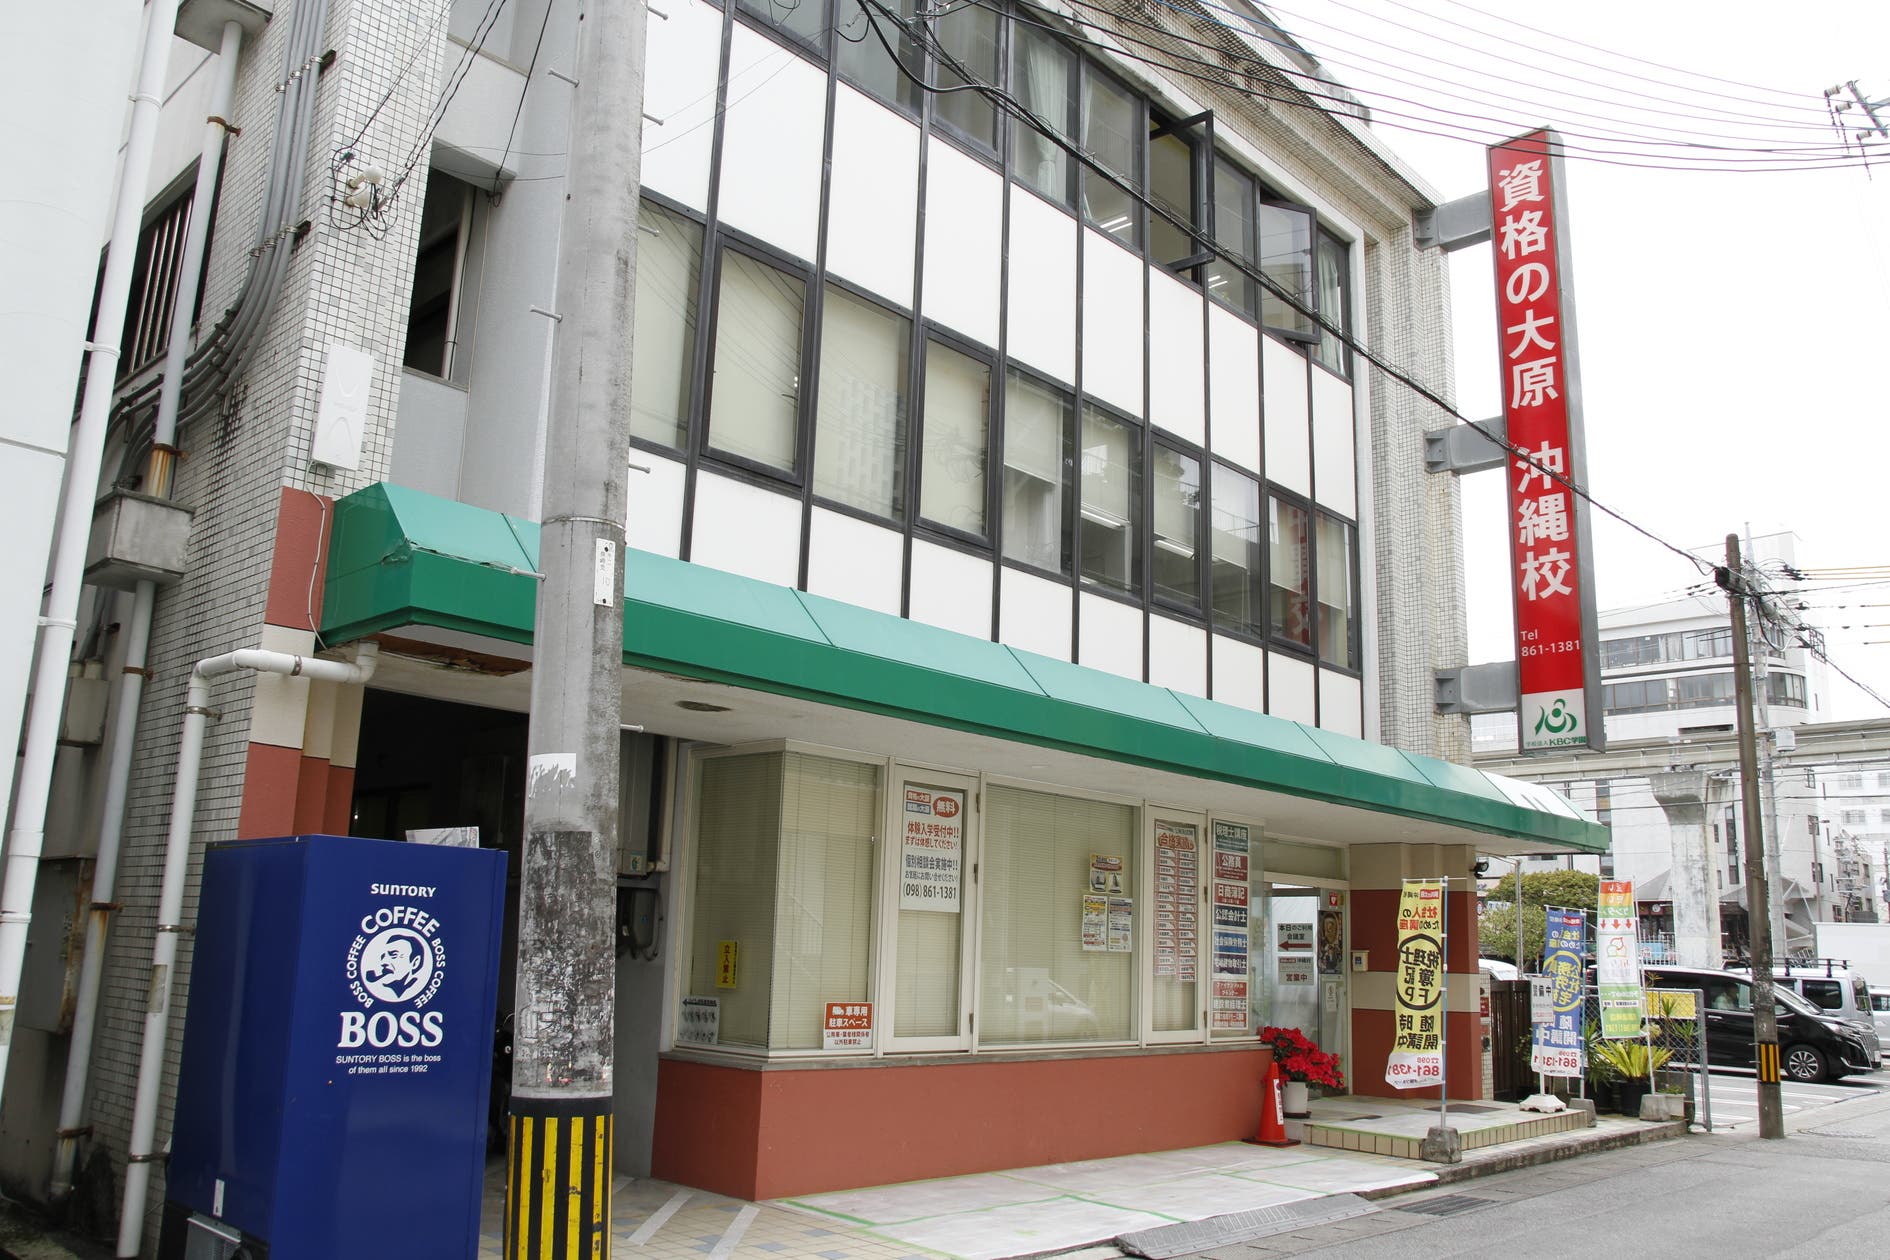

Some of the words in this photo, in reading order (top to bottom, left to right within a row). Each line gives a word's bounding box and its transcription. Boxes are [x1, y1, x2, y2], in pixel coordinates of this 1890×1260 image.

[1497, 159, 1559, 409] 資格の大原
[1514, 440, 1573, 601] 沖縄校
[1520, 629, 1538, 641] Tel
[1521, 639, 1581, 658] 861-1381
[370, 883, 437, 898] SUNTORY
[361, 906, 440, 937] COFFEE
[346, 934, 367, 979] COFFEE
[431, 937, 446, 968] BOSS
[350, 980, 375, 1008] BOSS
[414, 970, 444, 1009] COFFEE
[337, 1011, 443, 1047] BOSS
[335, 1055, 378, 1064] SUNTORY
[378, 1054, 402, 1063] BOSS
[403, 1054, 410, 1062] is
[411, 1054, 423, 1062] the
[424, 1054, 442, 1062] boss
[348, 1066, 357, 1075] of
[358, 1065, 377, 1074] them
[378, 1065, 388, 1073] all
[389, 1065, 409, 1073] since
[411, 1064, 428, 1073] 1992
